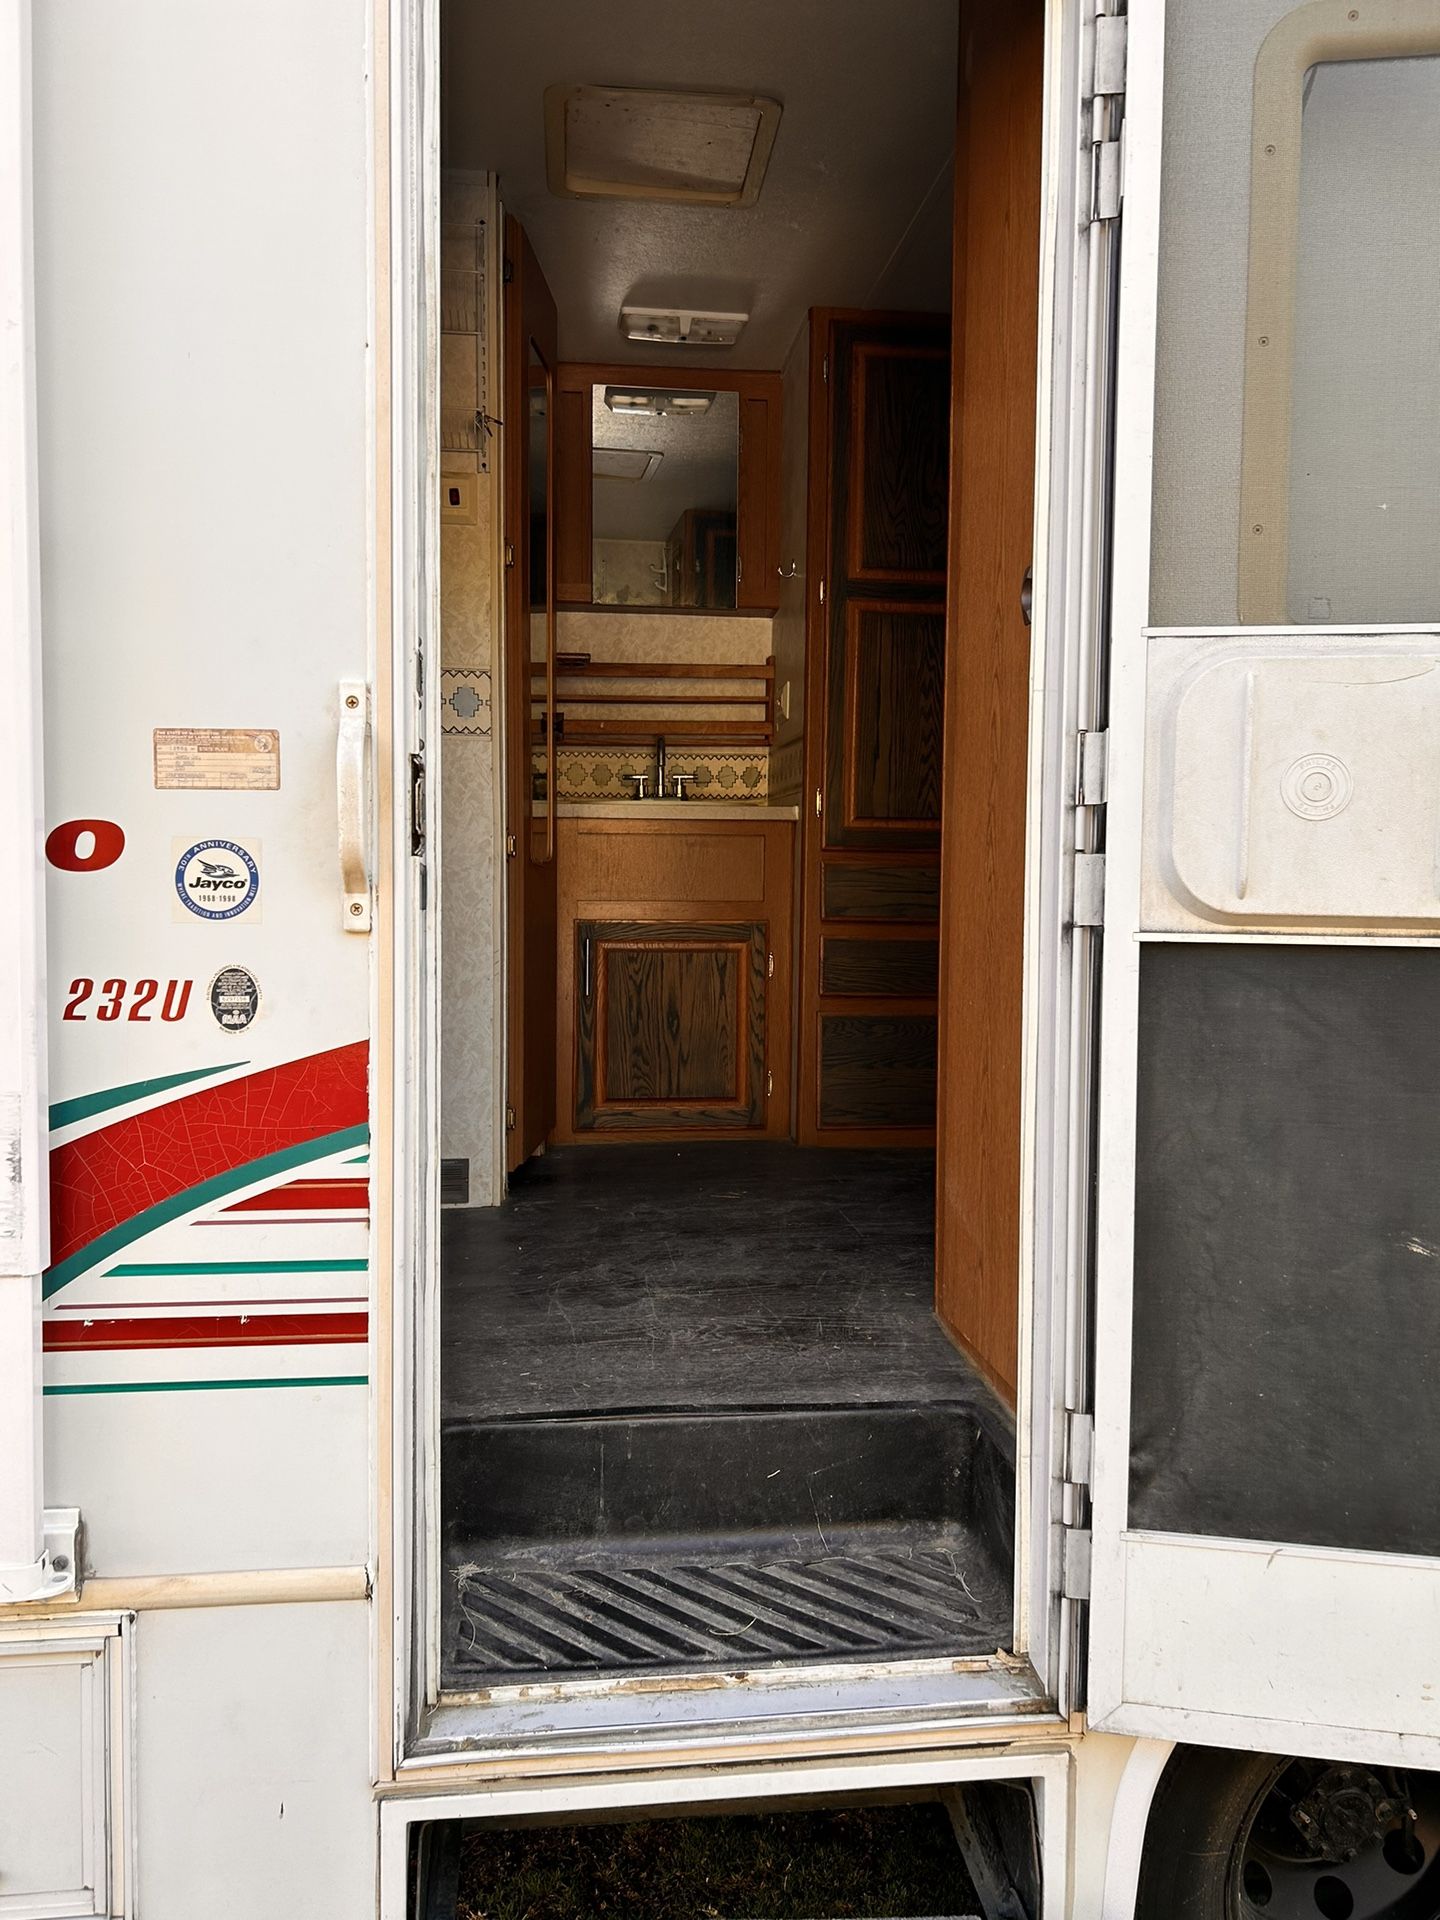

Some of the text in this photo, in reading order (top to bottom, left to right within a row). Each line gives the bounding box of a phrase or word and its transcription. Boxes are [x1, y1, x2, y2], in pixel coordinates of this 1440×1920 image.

[193, 841, 257, 873] ANNIVERSARY
[188, 877, 246, 891] Jayco
[62, 978, 193, 1021] 232U
